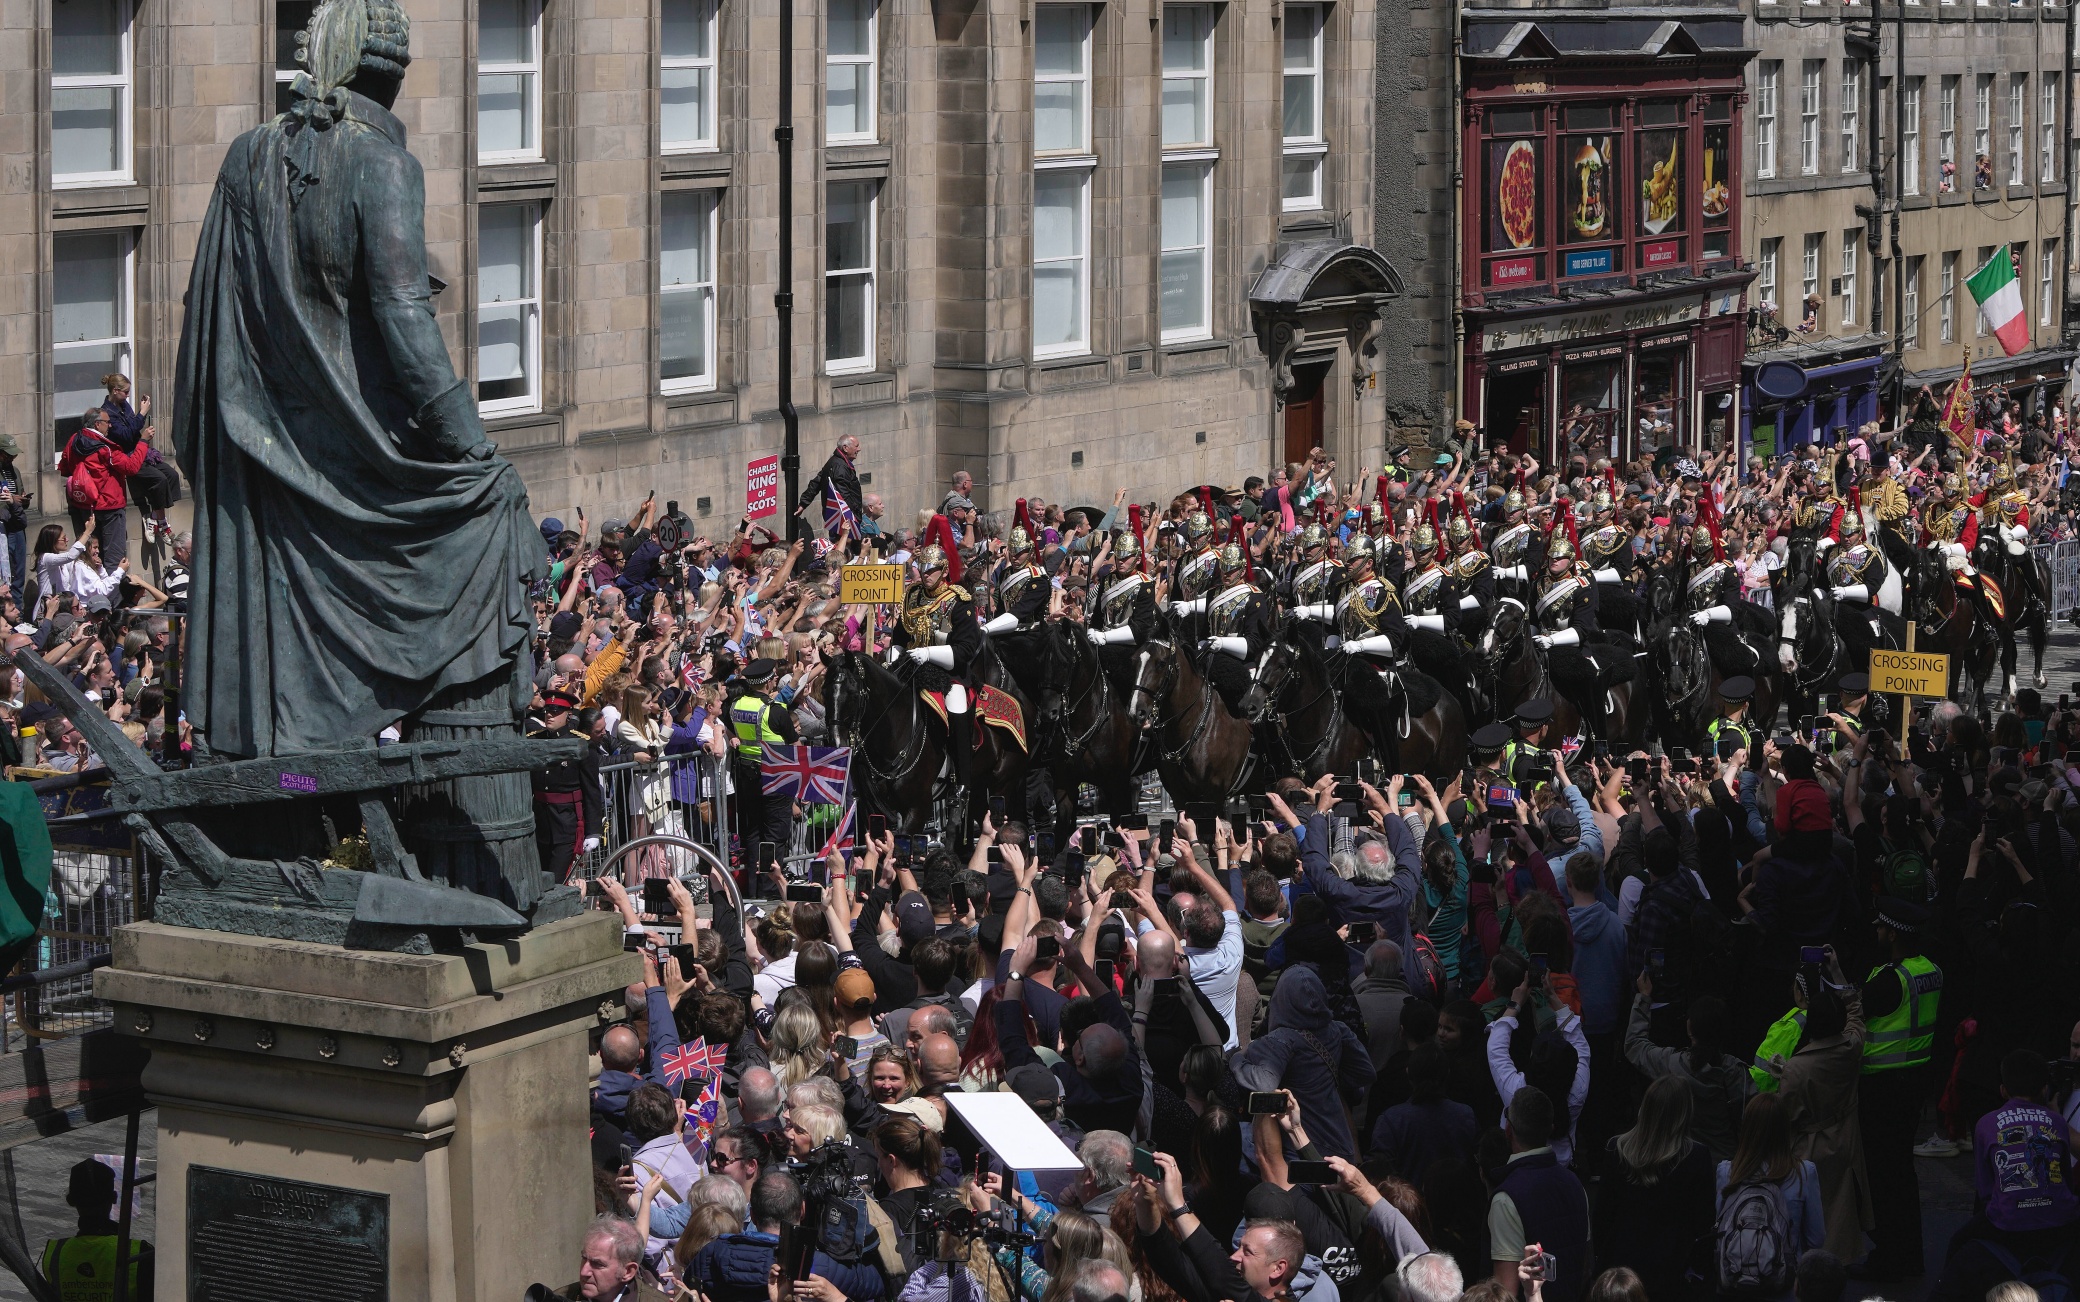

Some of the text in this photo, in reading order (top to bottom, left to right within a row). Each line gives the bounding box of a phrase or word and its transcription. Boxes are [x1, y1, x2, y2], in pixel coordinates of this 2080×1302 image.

[1519, 304, 1673, 344] THE FILLING STATION
[1565, 346, 1622, 361] PIZZA PASTA BURGERS
[1500, 359, 1538, 372] FILLING STATION
[748, 462, 777, 477] CHARLES
[748, 472, 777, 492] KING
[757, 489, 767, 498] OF
[747, 495, 776, 513] SCOTS
[660, 525, 675, 543] 20
[842, 569, 901, 582] CROSSING
[853, 588, 889, 601] POINT
[1873, 654, 1944, 673] CROSSING
[1885, 676, 1929, 692] POINT
[733, 710, 757, 723] POLICE
[281, 780, 317, 791] SCOTLAND
[1915, 974, 1942, 992] POLICE
[1996, 1107, 2048, 1121] BLACK
[1996, 1113, 2053, 1130] PANTHER
[246, 1183, 329, 1208] ADAM SMITH
[260, 1200, 315, 1220] 1723-1790
[62, 1280, 114, 1290] amberstone
[63, 1292, 114, 1302] SECURITY
